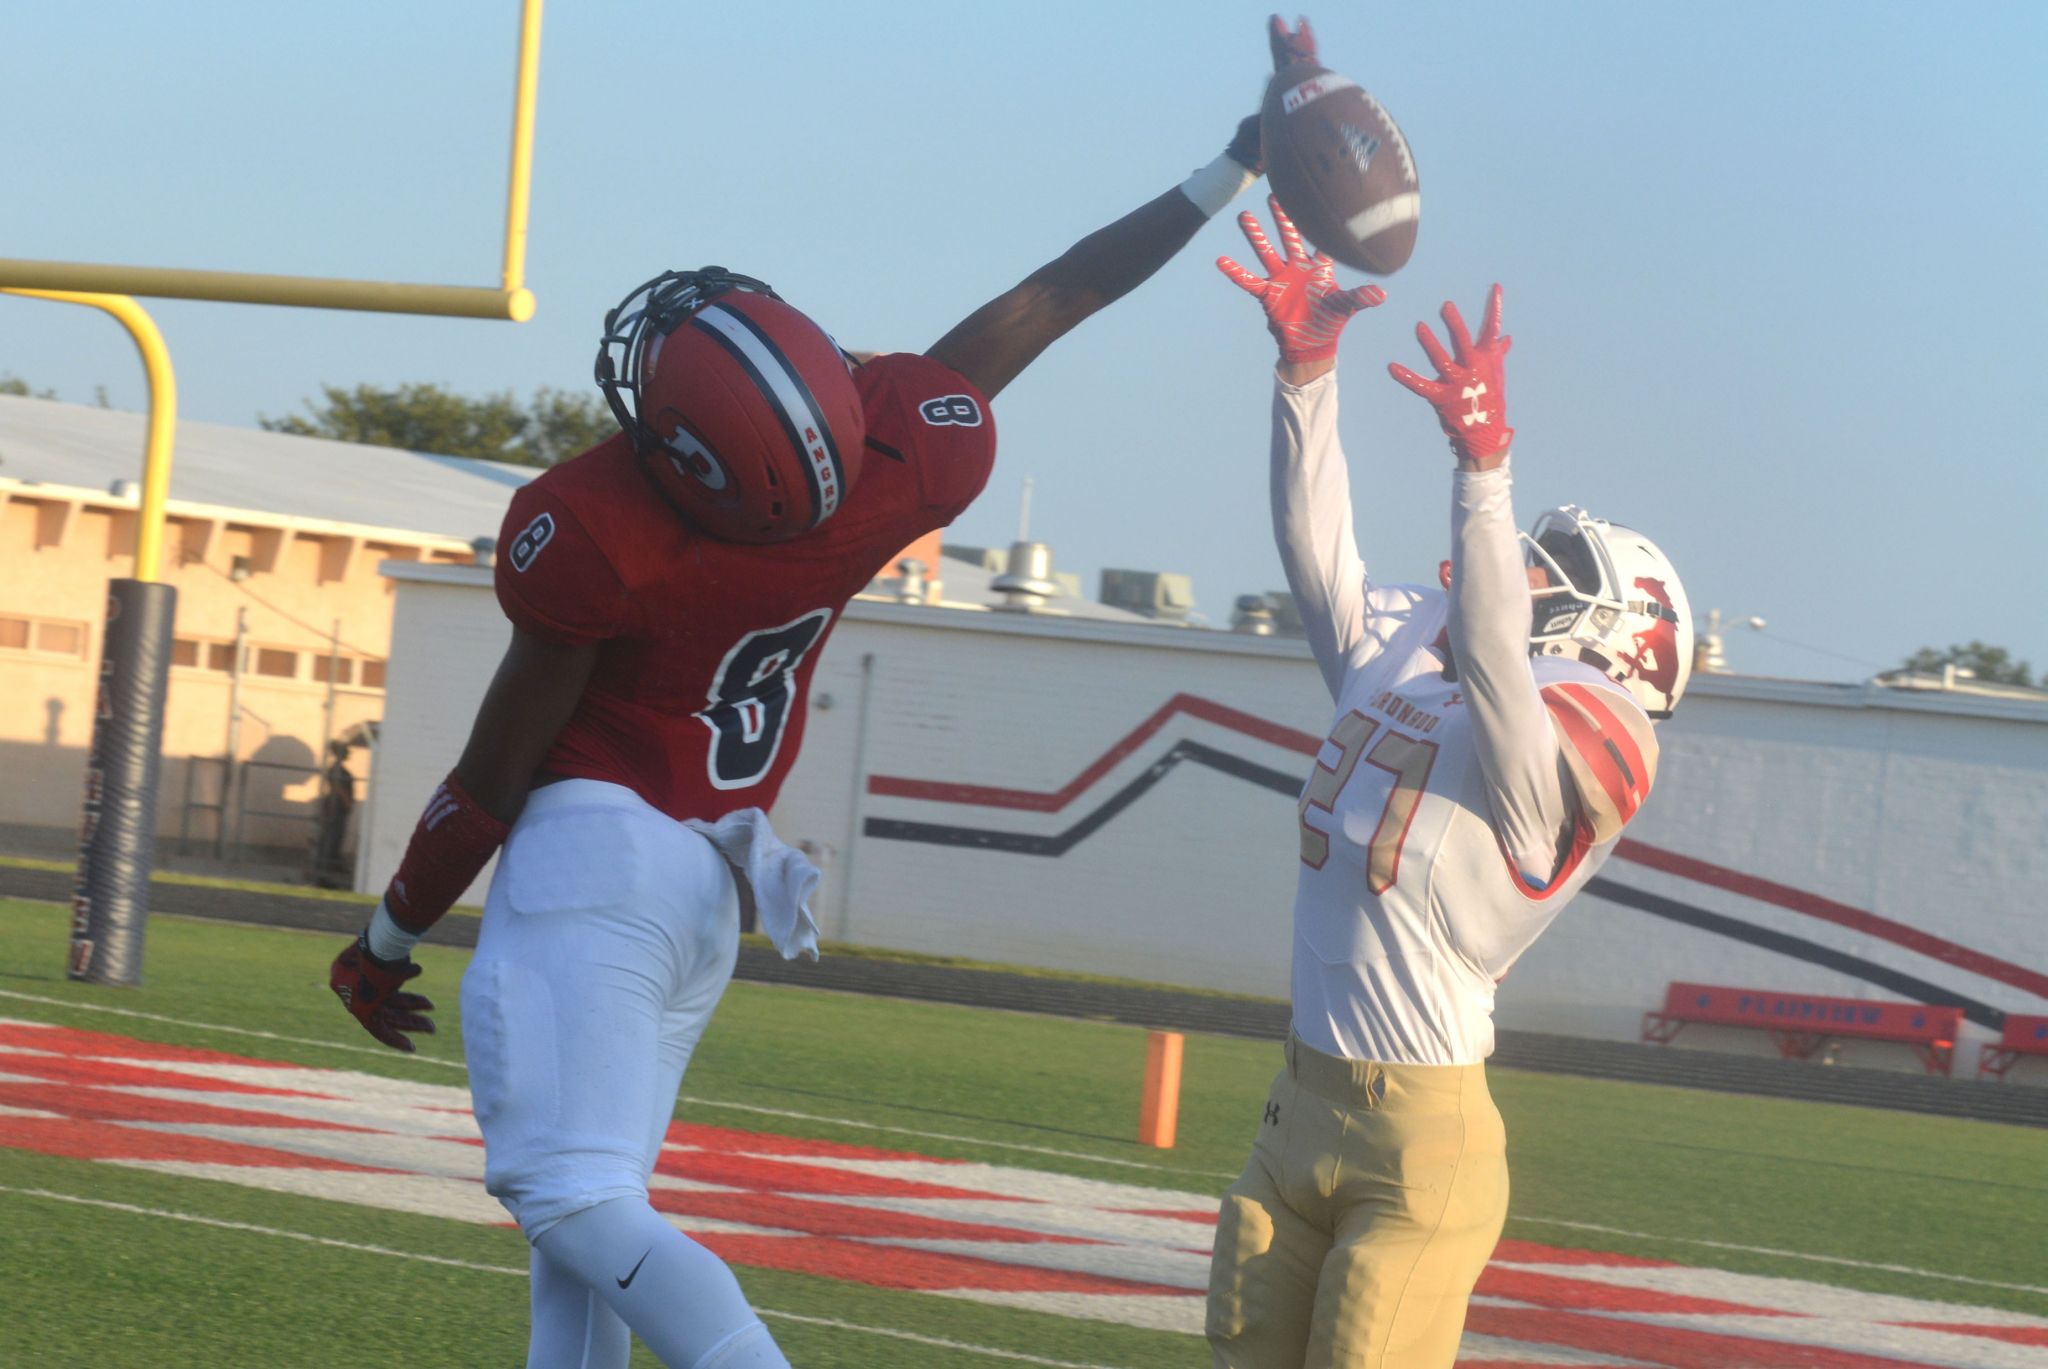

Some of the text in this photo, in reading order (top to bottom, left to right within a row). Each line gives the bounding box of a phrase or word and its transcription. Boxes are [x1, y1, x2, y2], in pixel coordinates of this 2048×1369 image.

[919, 394, 982, 427] 8
[804, 426, 835, 511] ANGRY
[509, 512, 555, 573] 8
[690, 607, 833, 791] 8
[1299, 708, 1441, 897] 27
[1737, 996, 1883, 1025] PLAINVIEW
